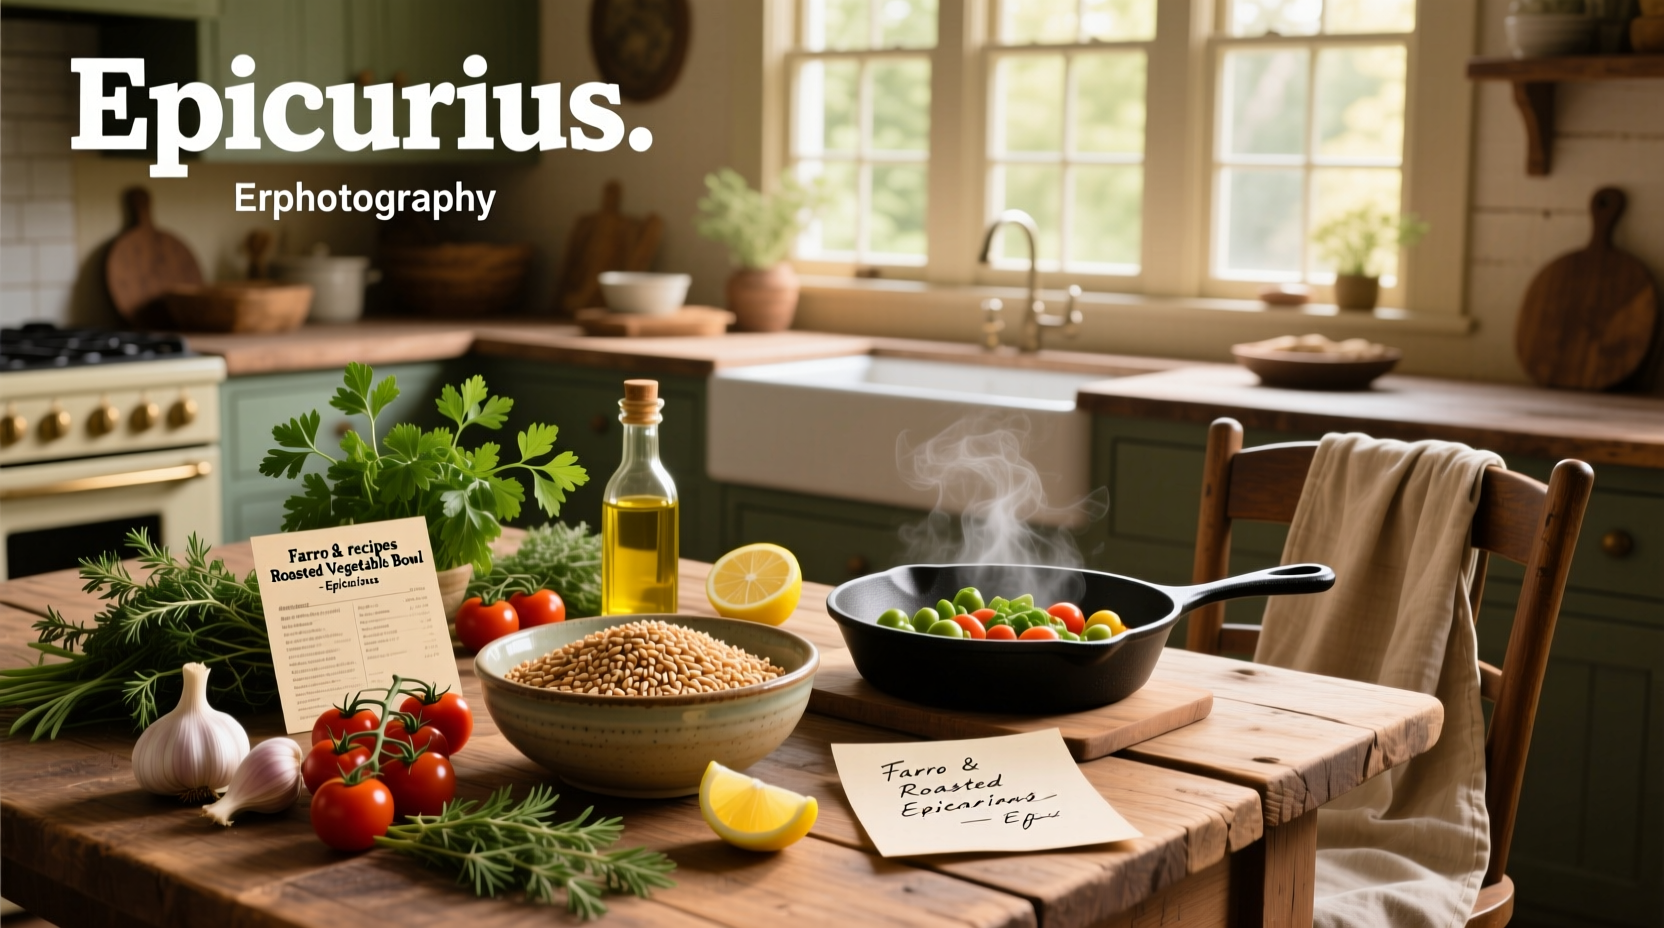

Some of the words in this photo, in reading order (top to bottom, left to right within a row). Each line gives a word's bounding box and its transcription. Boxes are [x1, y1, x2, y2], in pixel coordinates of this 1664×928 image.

[288, 548, 329, 564] Farro
[332, 543, 344, 559] &
[347, 540, 398, 558] recipes
[881, 759, 947, 782] Farro
[962, 757, 979, 771] &
[899, 774, 1003, 798] Roasted
